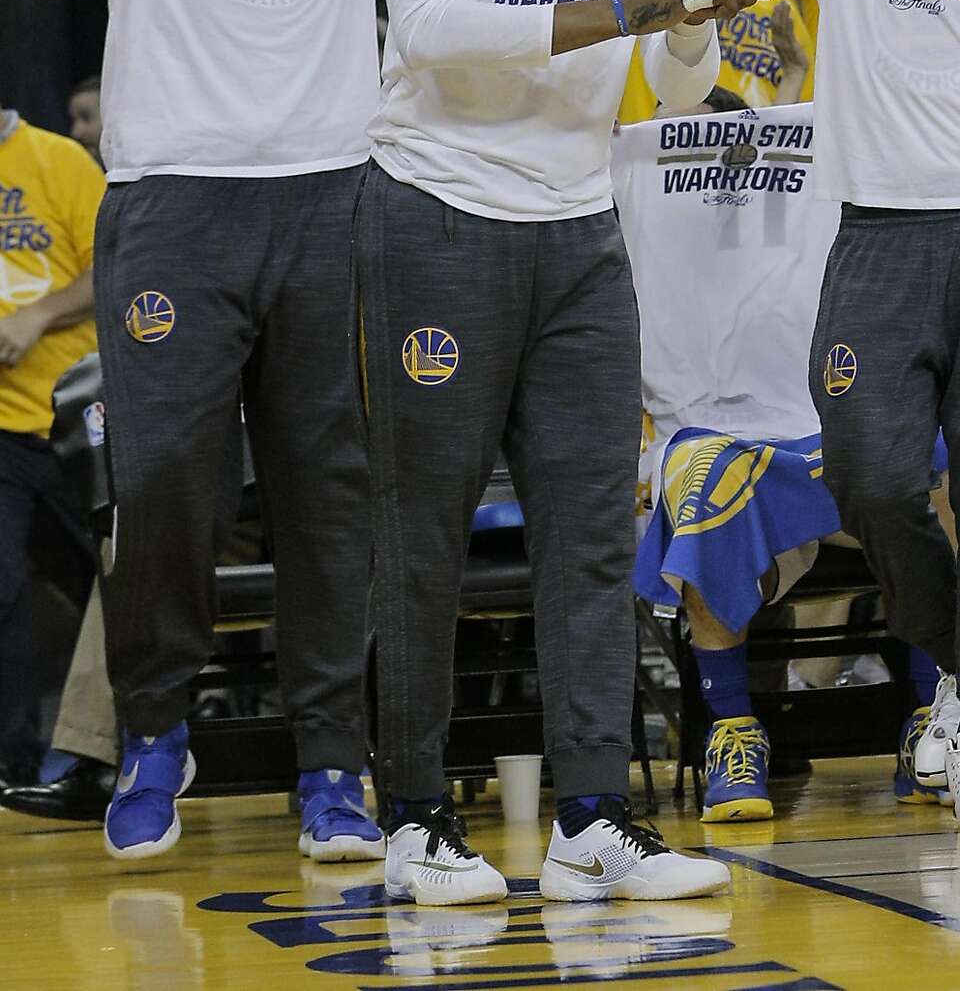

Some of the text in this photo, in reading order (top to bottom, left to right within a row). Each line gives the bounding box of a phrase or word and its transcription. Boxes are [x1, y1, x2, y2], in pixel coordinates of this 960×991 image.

[660, 121, 814, 150] GOLDEN STAT
[663, 166, 807, 194] WARRIORS
